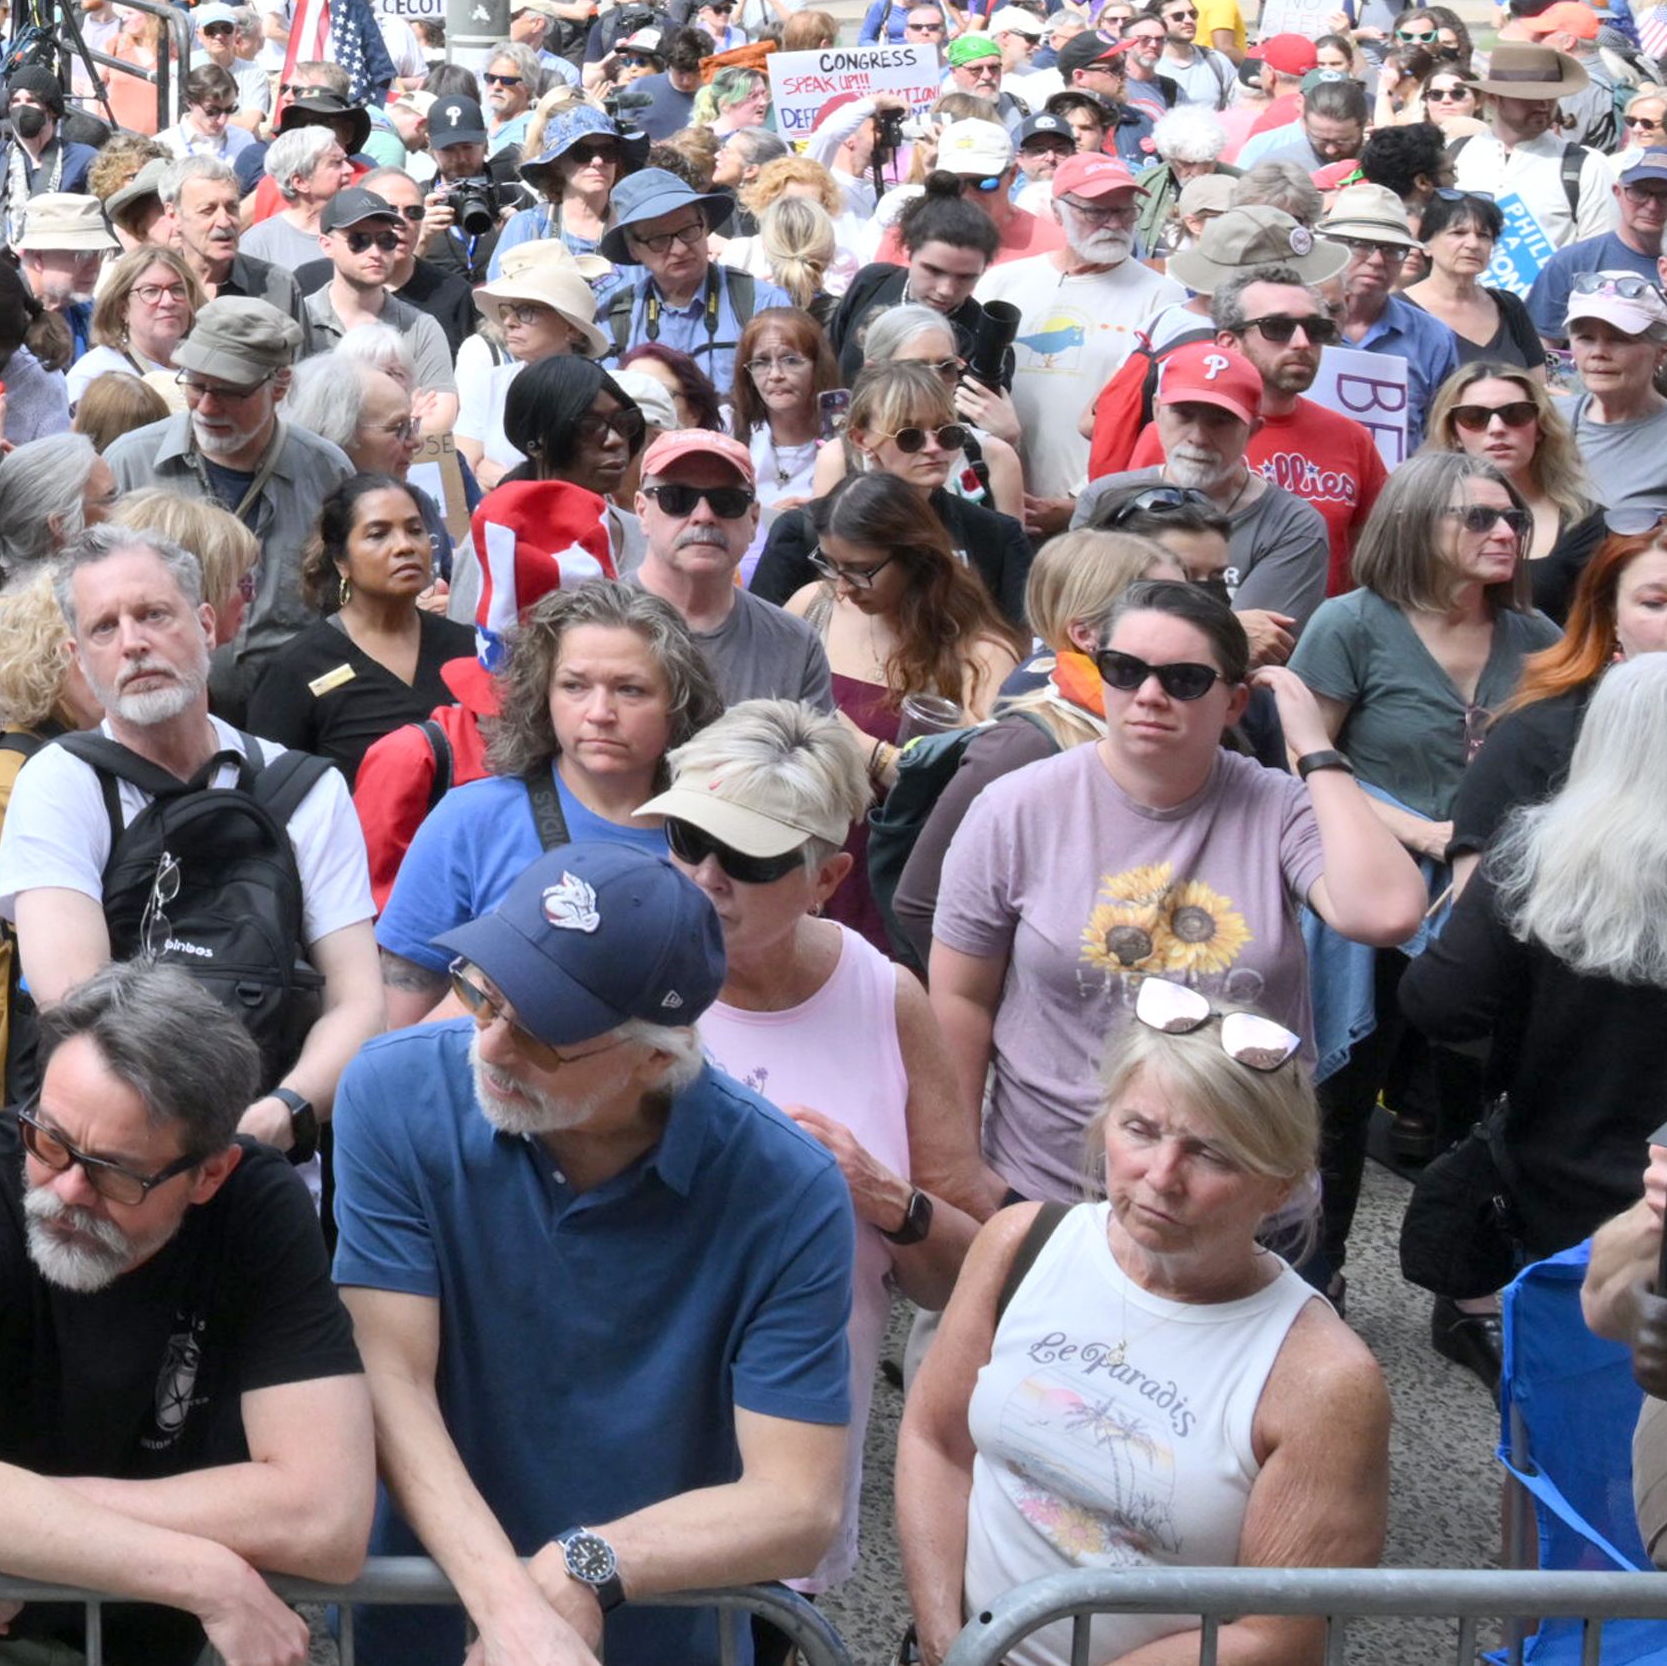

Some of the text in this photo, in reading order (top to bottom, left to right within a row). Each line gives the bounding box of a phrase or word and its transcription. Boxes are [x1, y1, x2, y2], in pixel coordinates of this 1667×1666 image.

[819, 49, 917, 72] CONGRESS
[783, 75, 837, 95] SPEAK
[1203, 354, 1229, 380] P
[1244, 452, 1357, 502] illies
[533, 788, 565, 849] IDAS
[1028, 1331, 1196, 1437] Le Paradis
